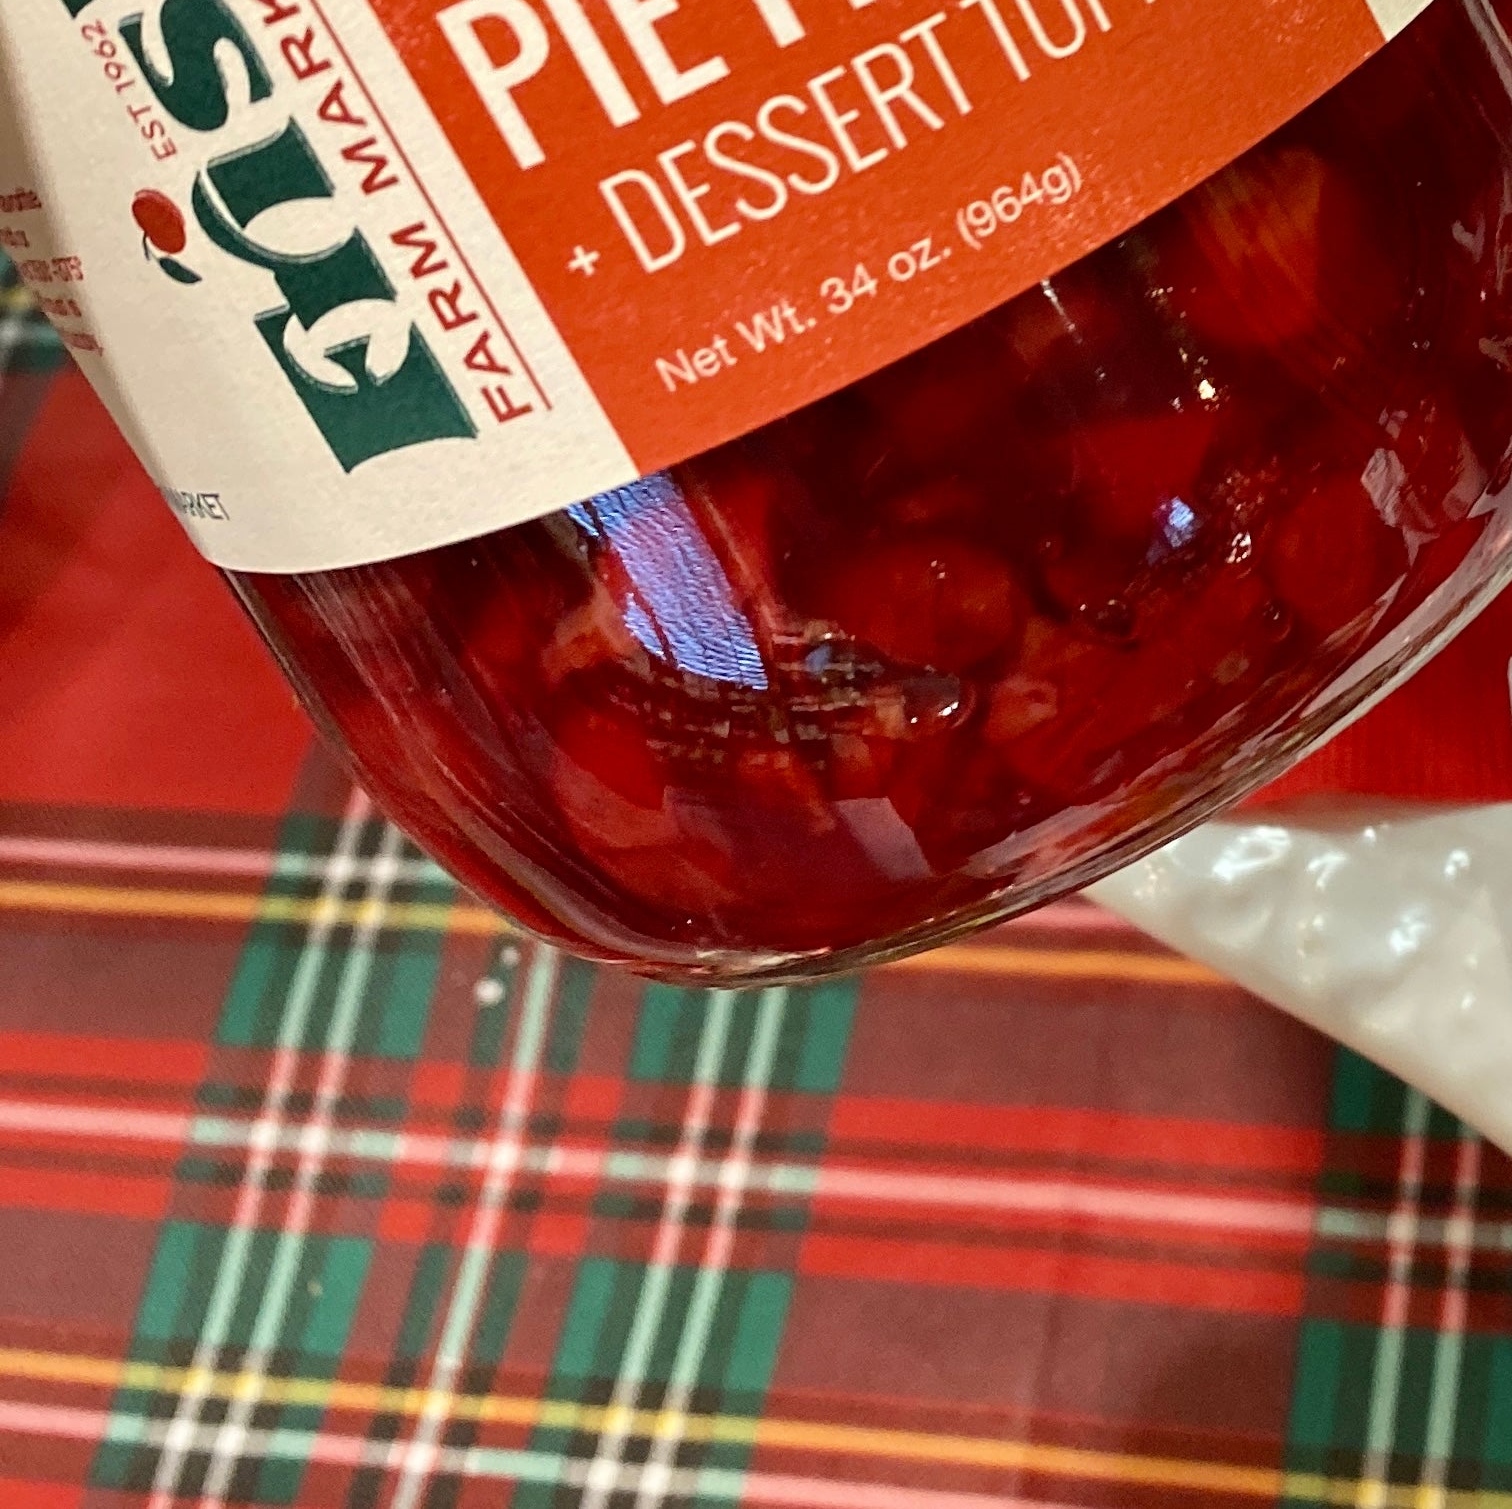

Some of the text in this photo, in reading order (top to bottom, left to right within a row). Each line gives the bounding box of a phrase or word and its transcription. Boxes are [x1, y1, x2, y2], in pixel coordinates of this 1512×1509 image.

[80, 18, 178, 162] EST 1962
[599, 12, 972, 273] DESSERT
[389, 220, 533, 423] FARM
[654, 151, 1083, 392] Net Wt. 34 oz. (964g)
